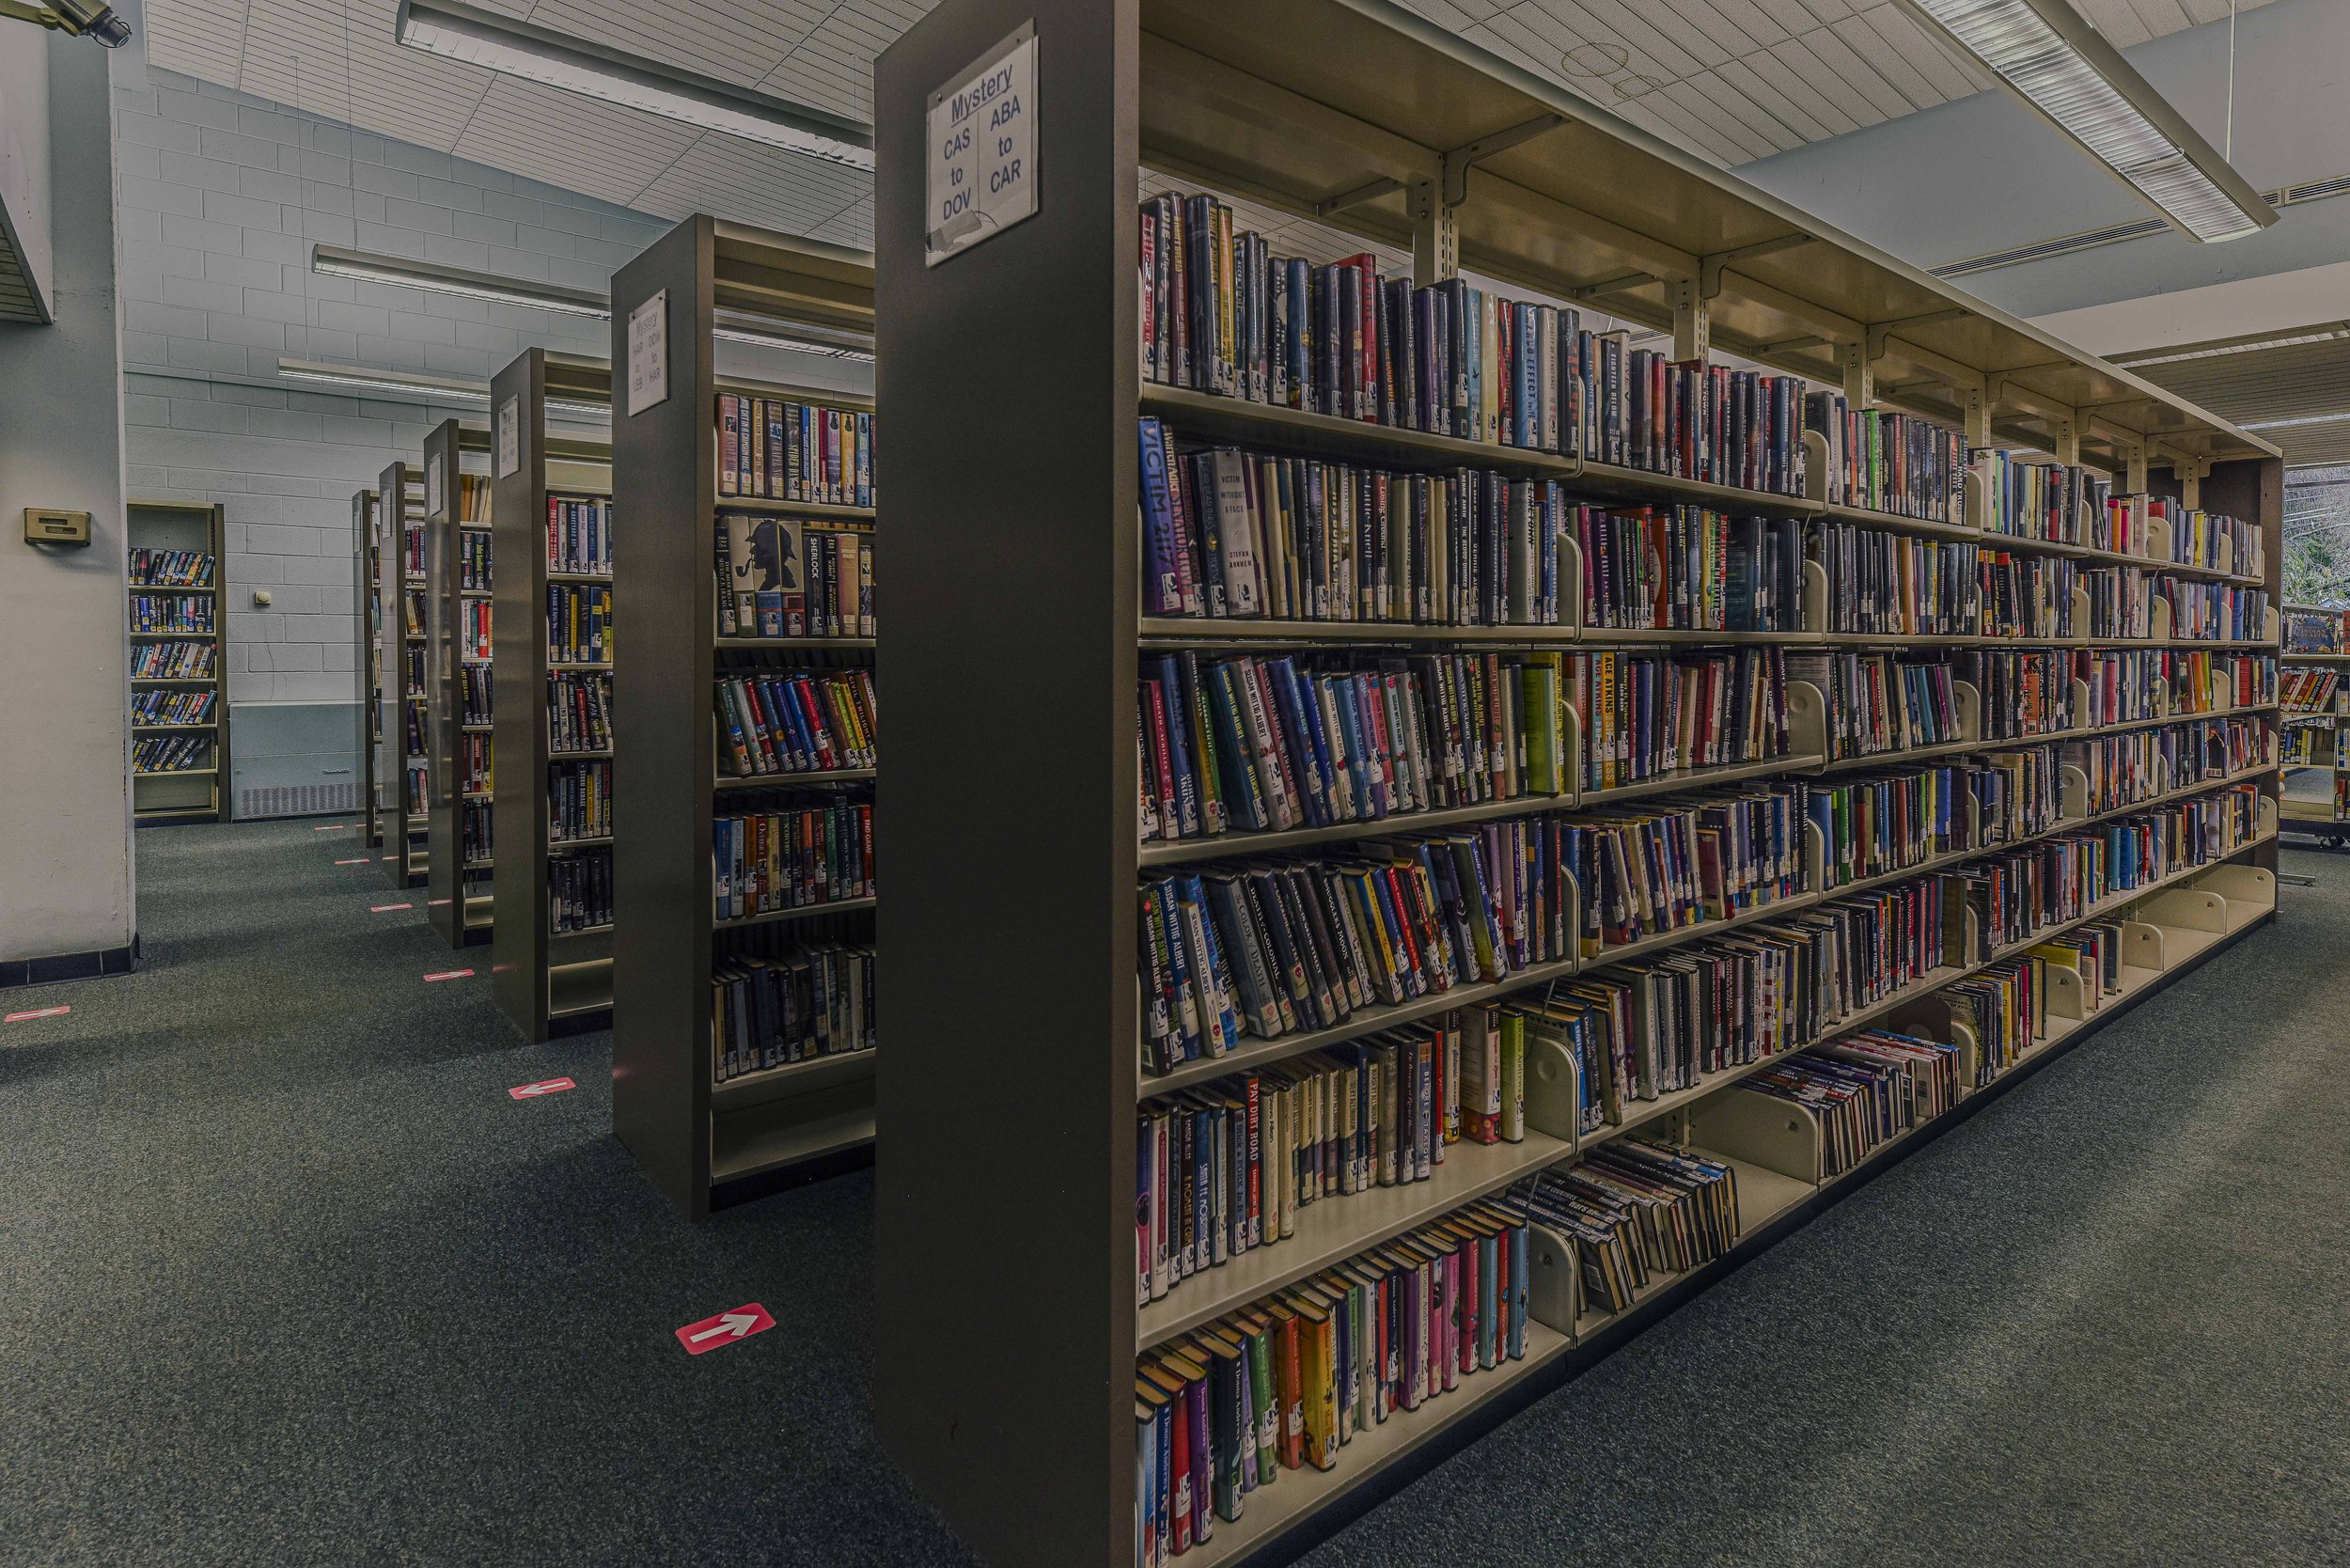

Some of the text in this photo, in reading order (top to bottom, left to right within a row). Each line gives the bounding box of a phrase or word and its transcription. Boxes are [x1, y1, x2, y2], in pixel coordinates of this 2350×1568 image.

[950, 64, 1013, 122] Mystery
[990, 95, 1022, 132] ABA
[943, 128, 971, 161] CAS
[998, 136, 1012, 157] to
[951, 168, 963, 187] to
[990, 159, 1022, 195] CAR
[943, 187, 971, 221] DOV
[1528, 358, 1536, 400] EFFECT
[1165, 431, 1180, 494] Warren Adler
[1144, 424, 1175, 567] VICTIM 2117
[810, 538, 819, 579] SHERLOCK
[1605, 656, 1614, 713] ACE ATKINS
[849, 676, 871, 739] CIVIL TWILIGHT
[1245, 668, 1267, 739] SUSAN WITTIG ALBERT
[1442, 707, 1450, 731] ALBERT
[1449, 703, 1458, 725] ALBERT
[1233, 715, 1245, 740] ALBERT
[1396, 892, 1408, 927] ALEXANDER
[1411, 869, 1428, 923] ELLIE ALEXANDER
[1165, 885, 1185, 970] SUSAN WITTIG ALBERT
[1338, 930, 1349, 960] MOON
[1146, 915, 1163, 994] SUSAN WITTIG ALBERT
[1157, 941, 1167, 966] ALBERT
[1190, 913, 1211, 996] SUSAN WITTIG ALBERT
[1238, 905, 1265, 988] COLOR DEATH
[1263, 933, 1280, 980] COLONIAL
[1249, 1083, 1259, 1103] PAY
[1249, 1105, 1259, 1131] DIRT
[1249, 1131, 1259, 1161] ROAD
[1237, 1203, 1244, 1213] It
